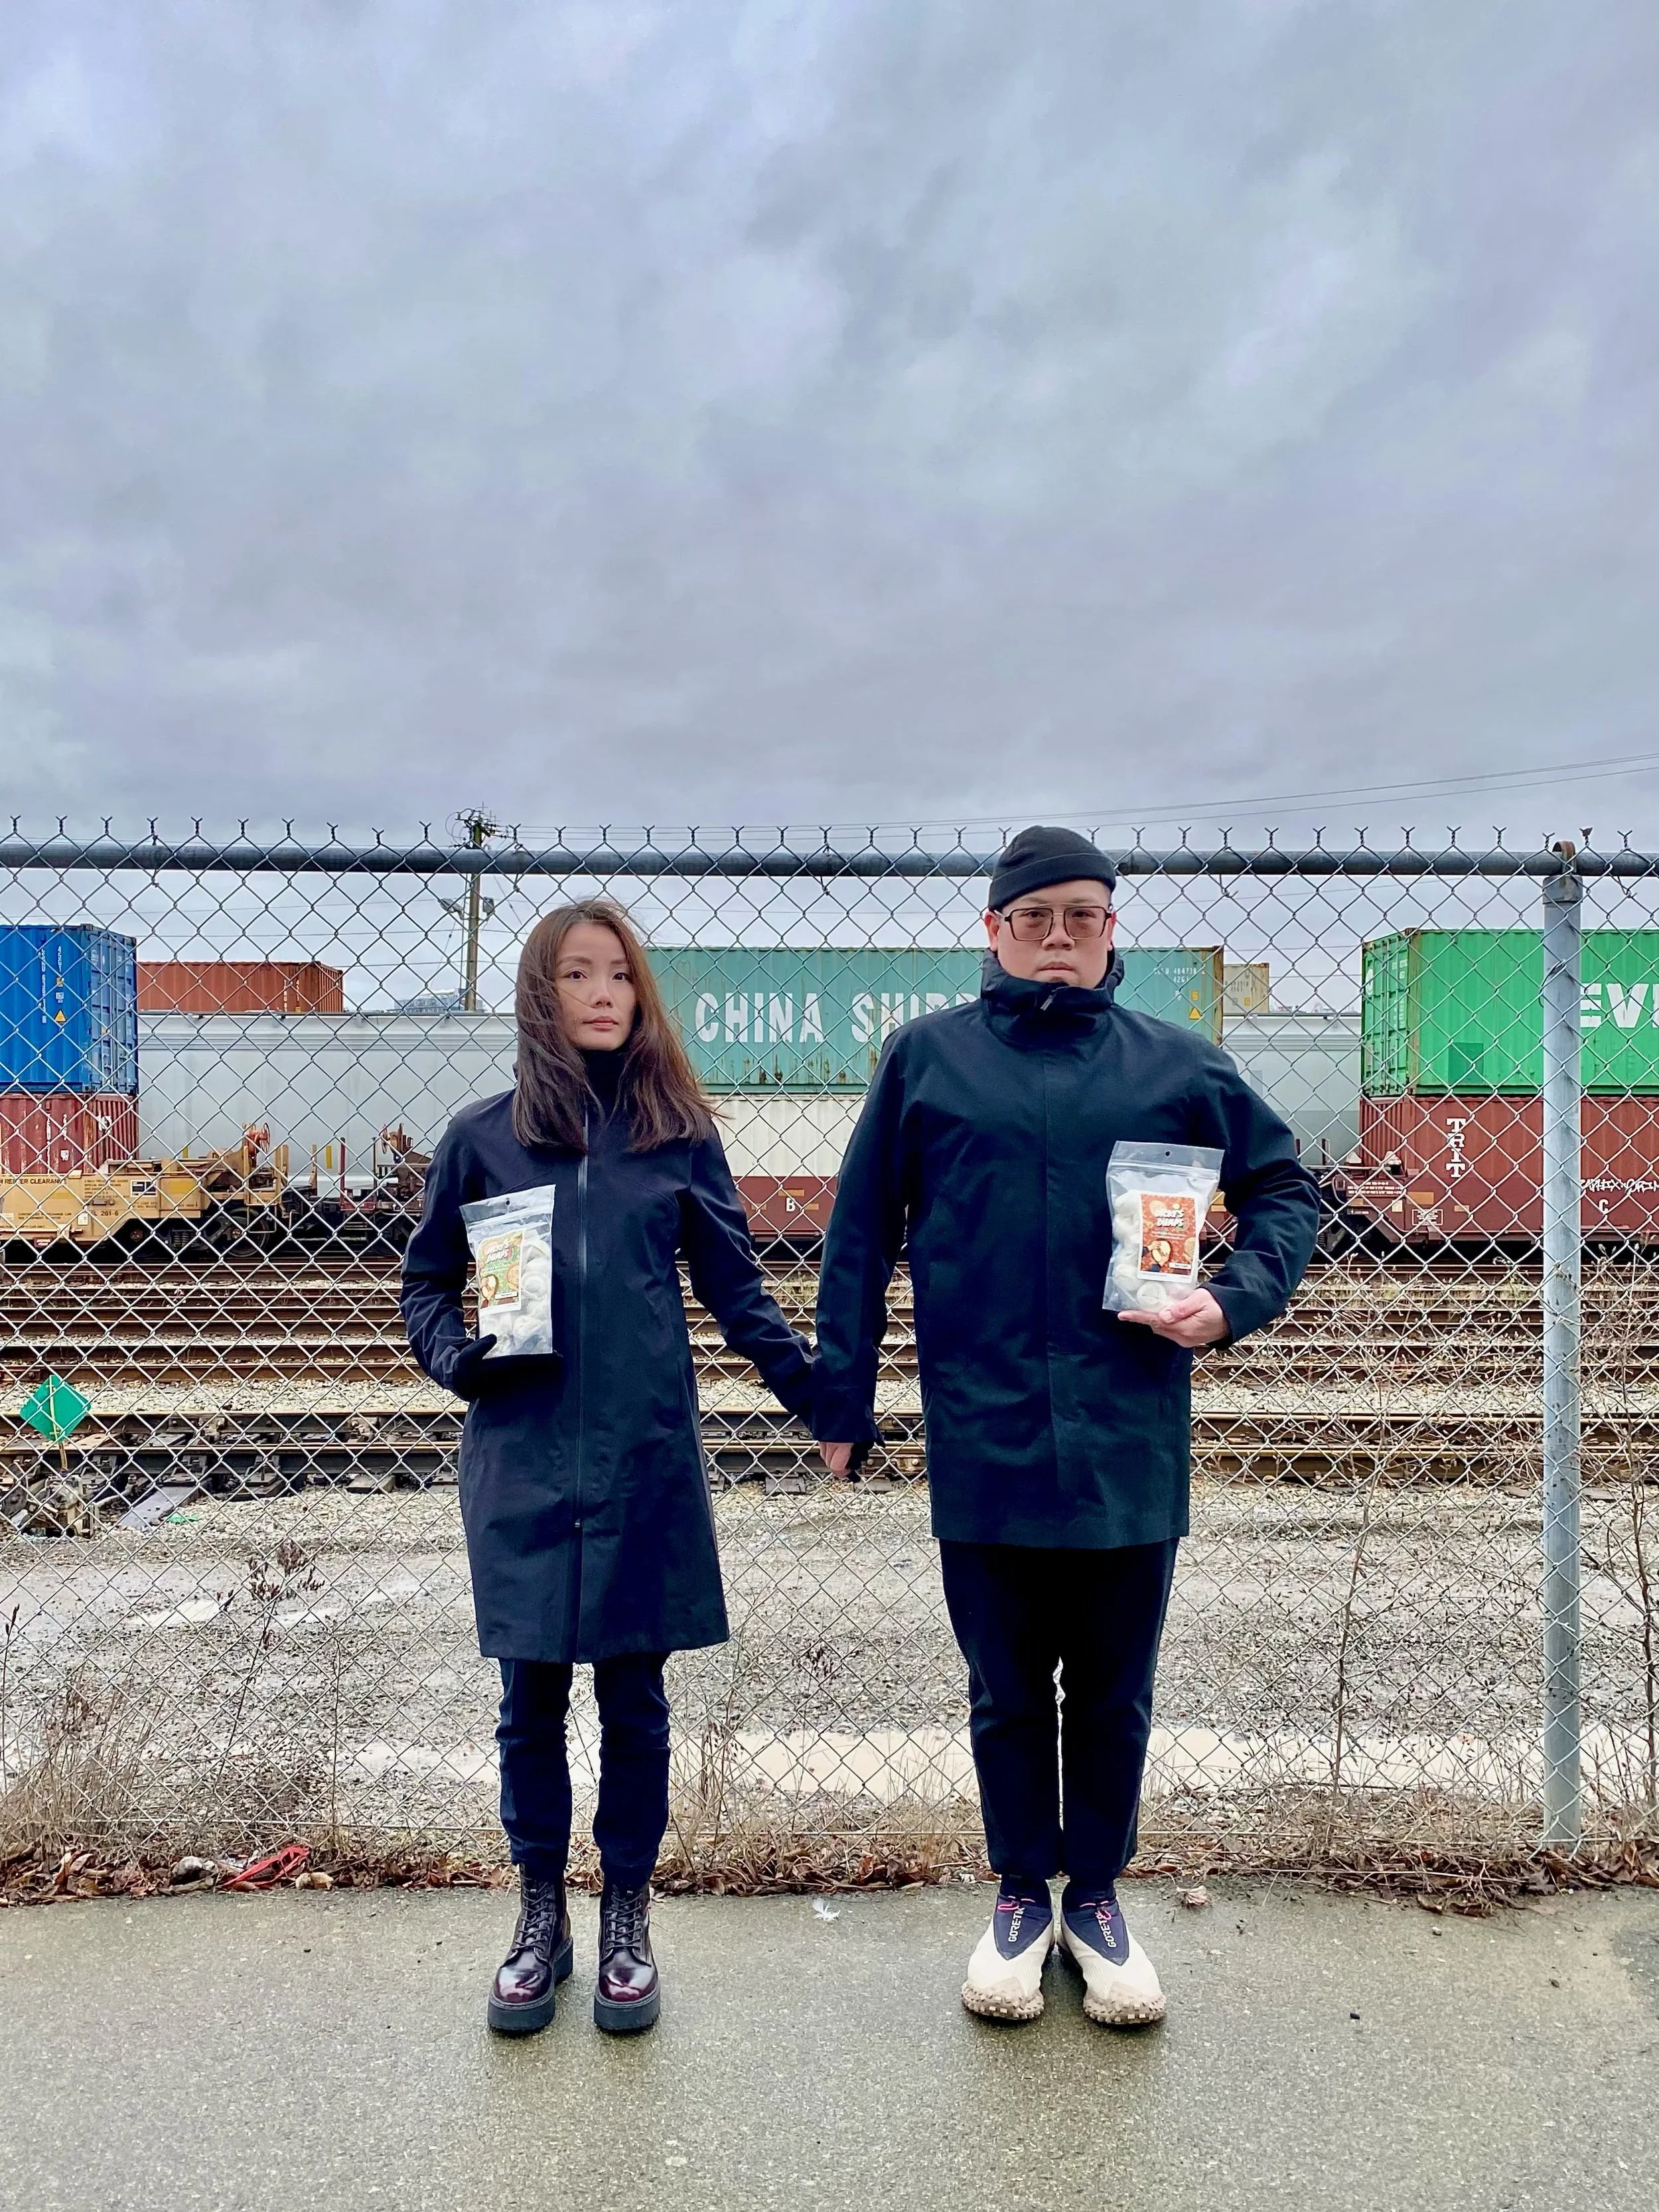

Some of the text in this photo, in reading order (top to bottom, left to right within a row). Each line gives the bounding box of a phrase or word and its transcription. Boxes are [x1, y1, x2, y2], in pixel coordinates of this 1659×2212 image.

[695, 992, 824, 1043] CHINA
[786, 1197, 796, 1212] B
[1599, 1199, 1609, 1215] C
